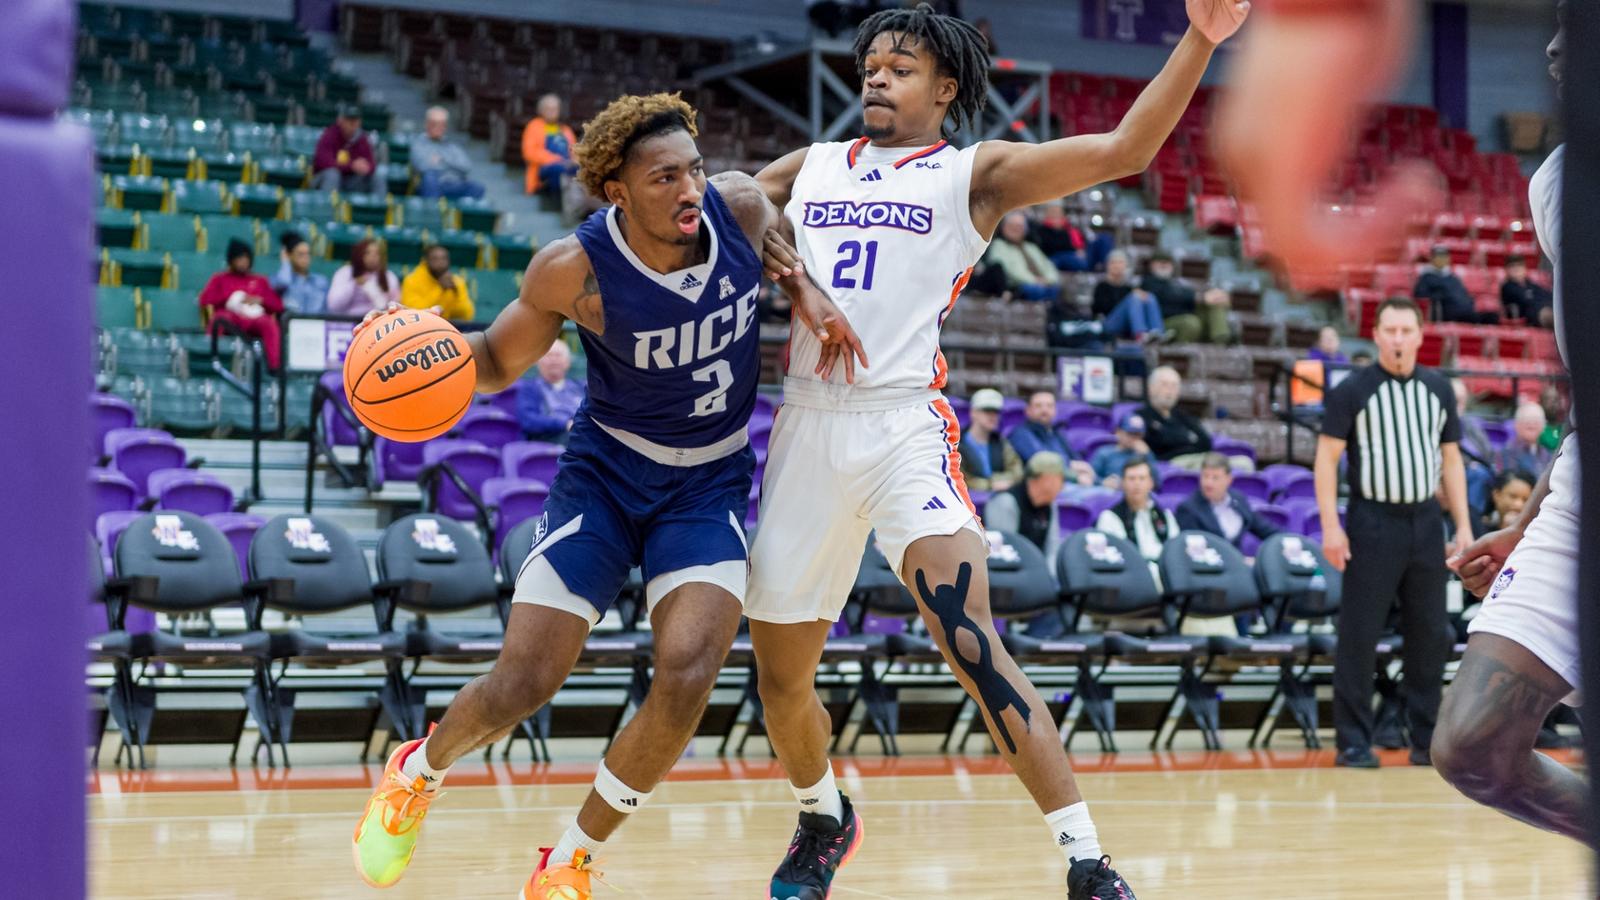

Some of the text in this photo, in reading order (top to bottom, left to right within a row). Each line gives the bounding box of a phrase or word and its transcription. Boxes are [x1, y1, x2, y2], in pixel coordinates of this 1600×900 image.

[803, 202, 932, 233] DEMONS
[831, 240, 878, 290] 21
[632, 282, 760, 369] RICE
[376, 338, 461, 383] Wilson
[1062, 363, 1082, 392] F
[688, 358, 734, 417] 2
